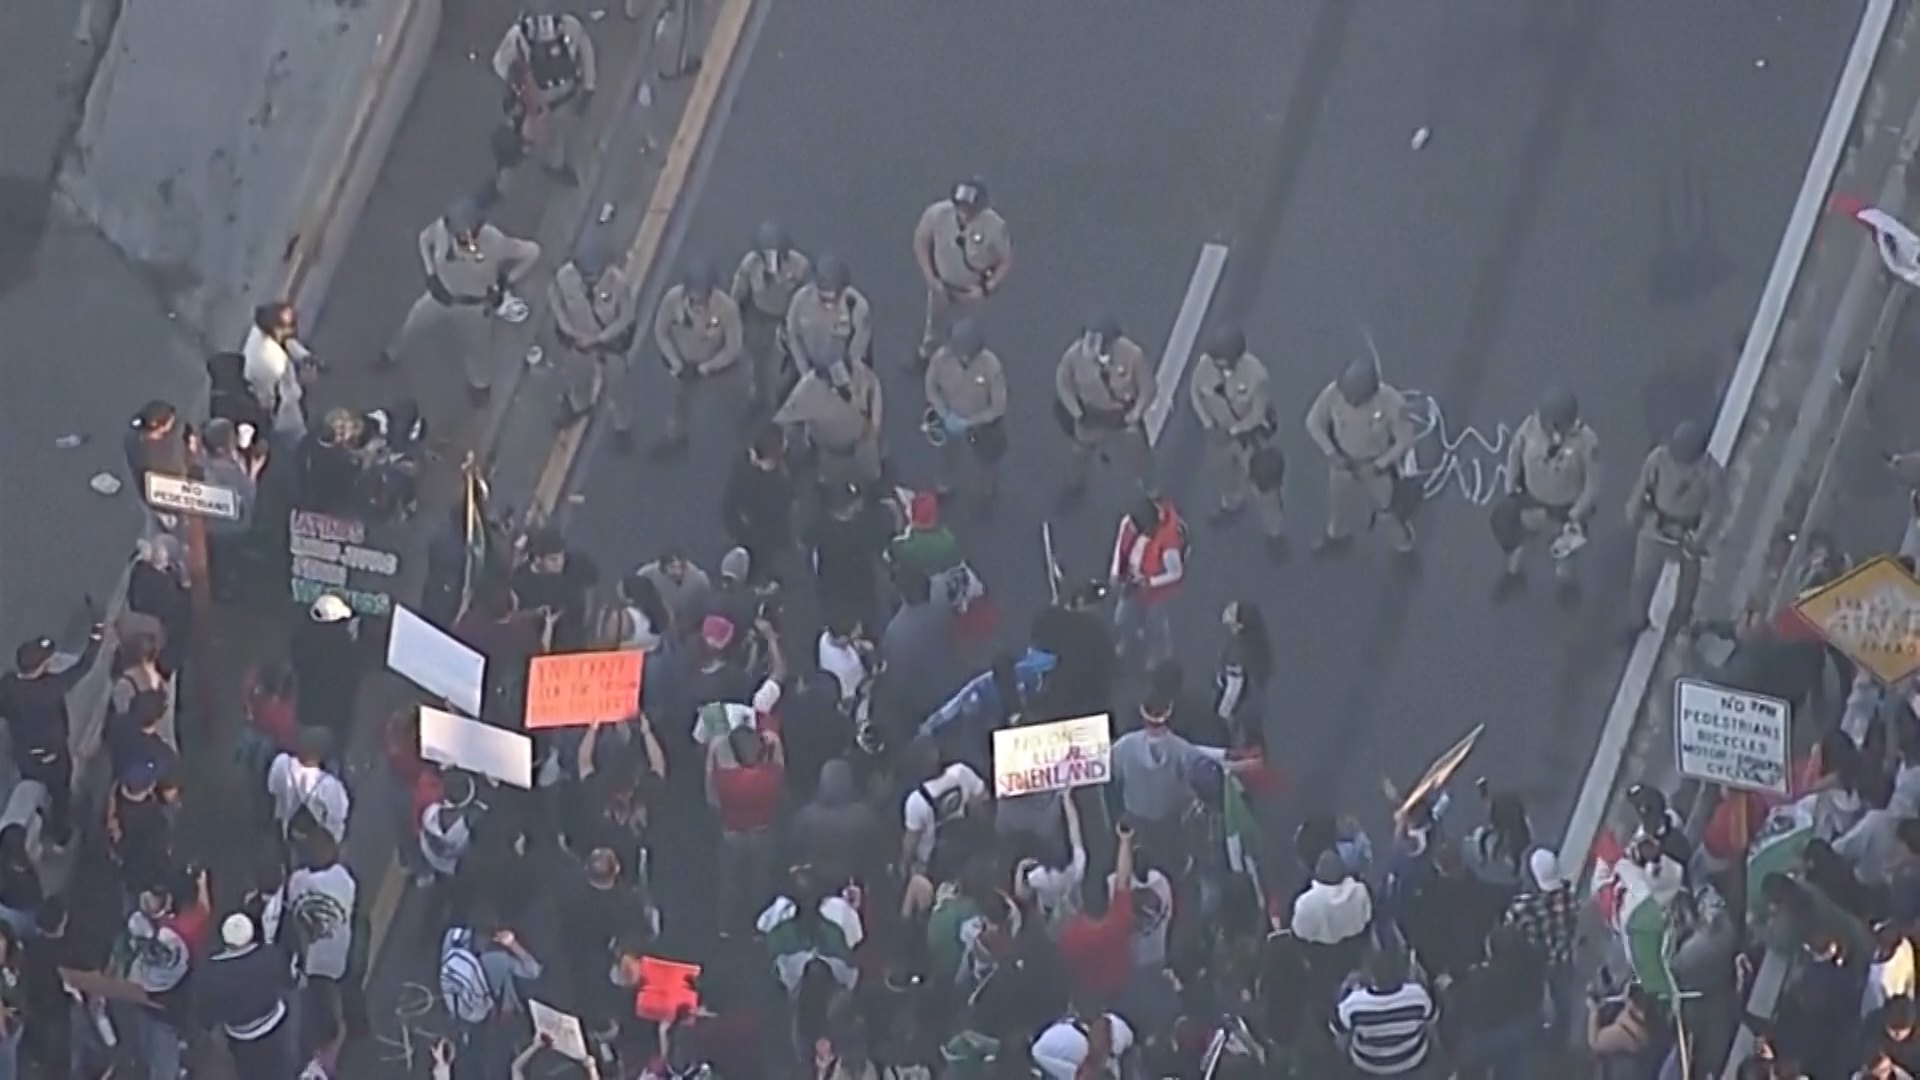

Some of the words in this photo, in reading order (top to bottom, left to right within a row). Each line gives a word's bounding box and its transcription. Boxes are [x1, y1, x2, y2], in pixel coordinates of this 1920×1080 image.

[154, 491, 231, 513] PEDESTRIANS
[181, 484, 203, 497] NO
[1721, 696, 1746, 714] NO
[1683, 708, 1780, 741] PEDESTRIANS
[1697, 729, 1767, 755] BICYCLES
[1053, 760, 1106, 787] LAND
